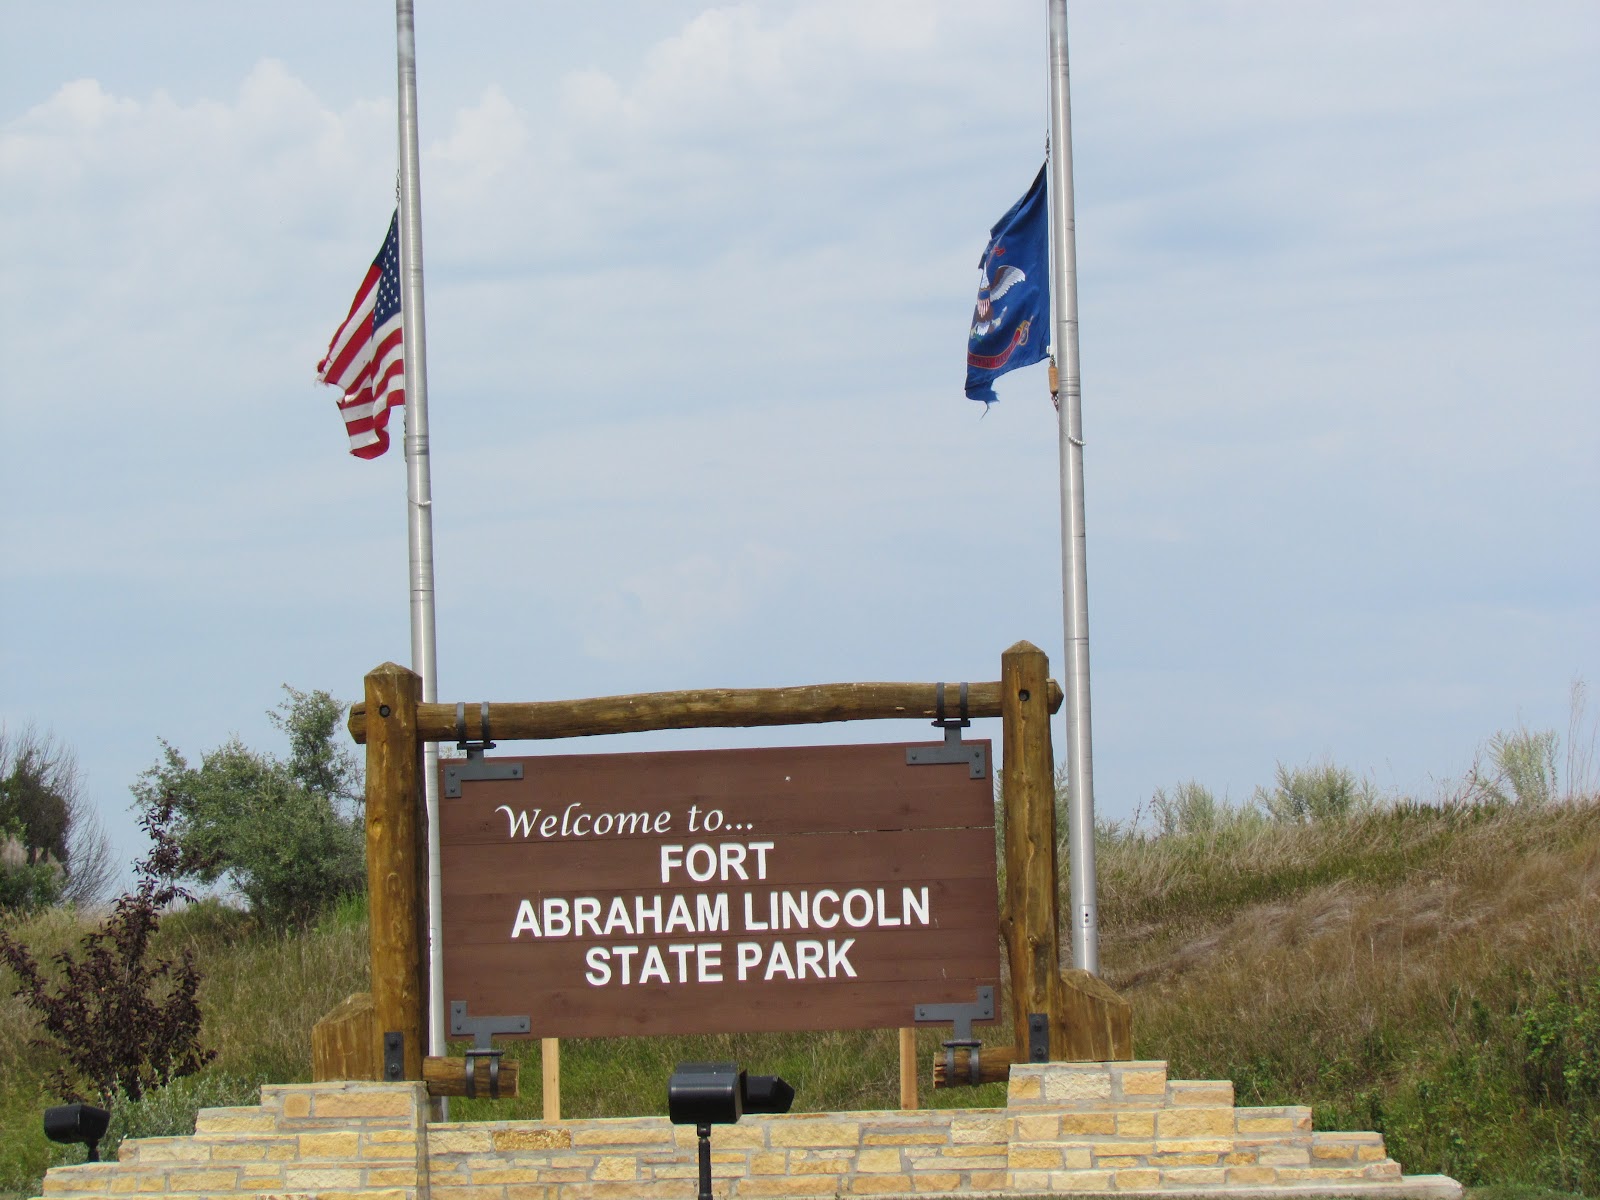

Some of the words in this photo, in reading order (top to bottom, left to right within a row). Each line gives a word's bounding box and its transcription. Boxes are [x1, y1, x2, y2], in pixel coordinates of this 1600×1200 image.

[494, 803, 672, 838] Welcome
[688, 805, 754, 832] to...
[660, 842, 775, 884] FORT
[511, 893, 730, 938] ABRAHAM
[744, 887, 930, 932] LINCOLN
[585, 943, 724, 985] STATE
[737, 939, 858, 982] PARK
